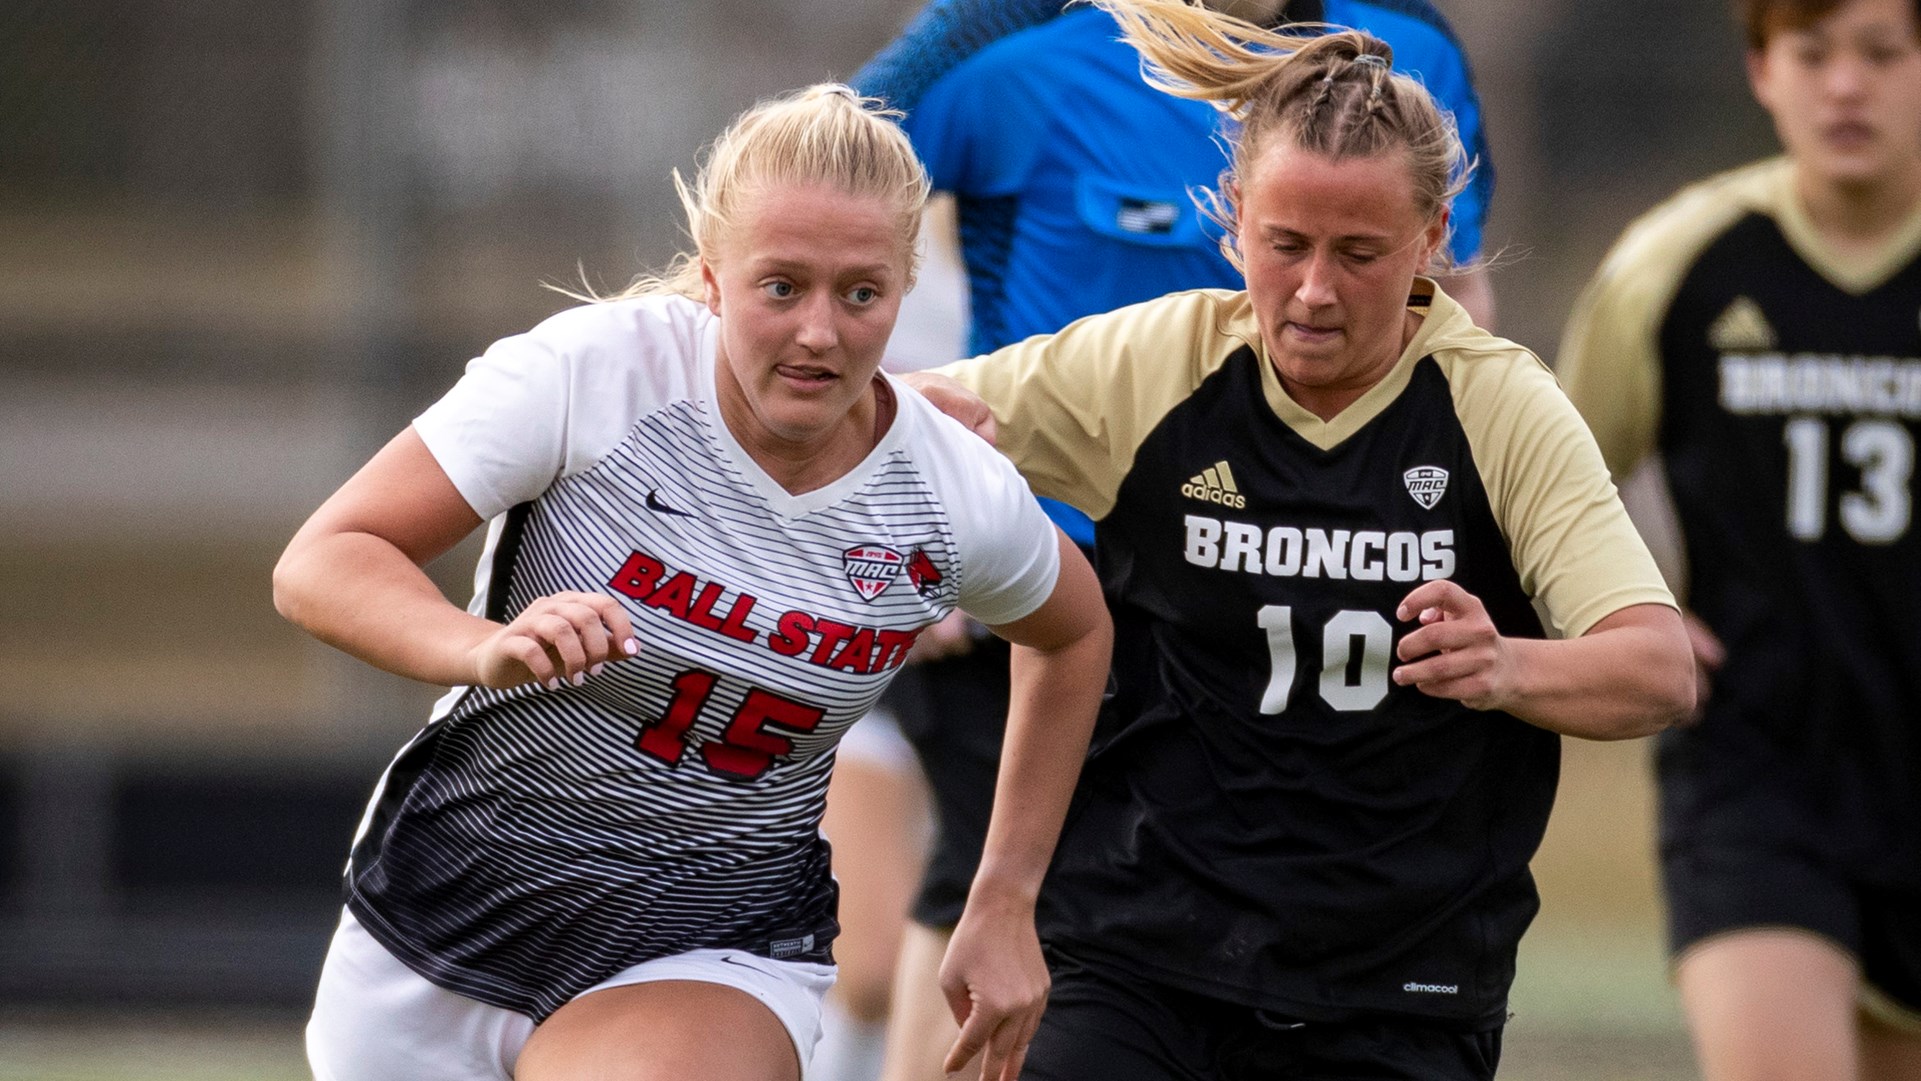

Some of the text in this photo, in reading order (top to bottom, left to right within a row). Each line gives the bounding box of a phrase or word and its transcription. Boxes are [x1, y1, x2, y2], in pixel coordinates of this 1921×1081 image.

[1181, 483, 1246, 509] adidas
[1408, 480, 1446, 491] MAC
[1783, 416, 1915, 545] 13
[845, 561, 898, 578] MAC
[1184, 514, 1455, 582] BRONCOS
[607, 550, 758, 643] BALL
[1257, 604, 1393, 715] 10
[634, 668, 827, 781] 15
[1403, 982, 1458, 994] climacool
